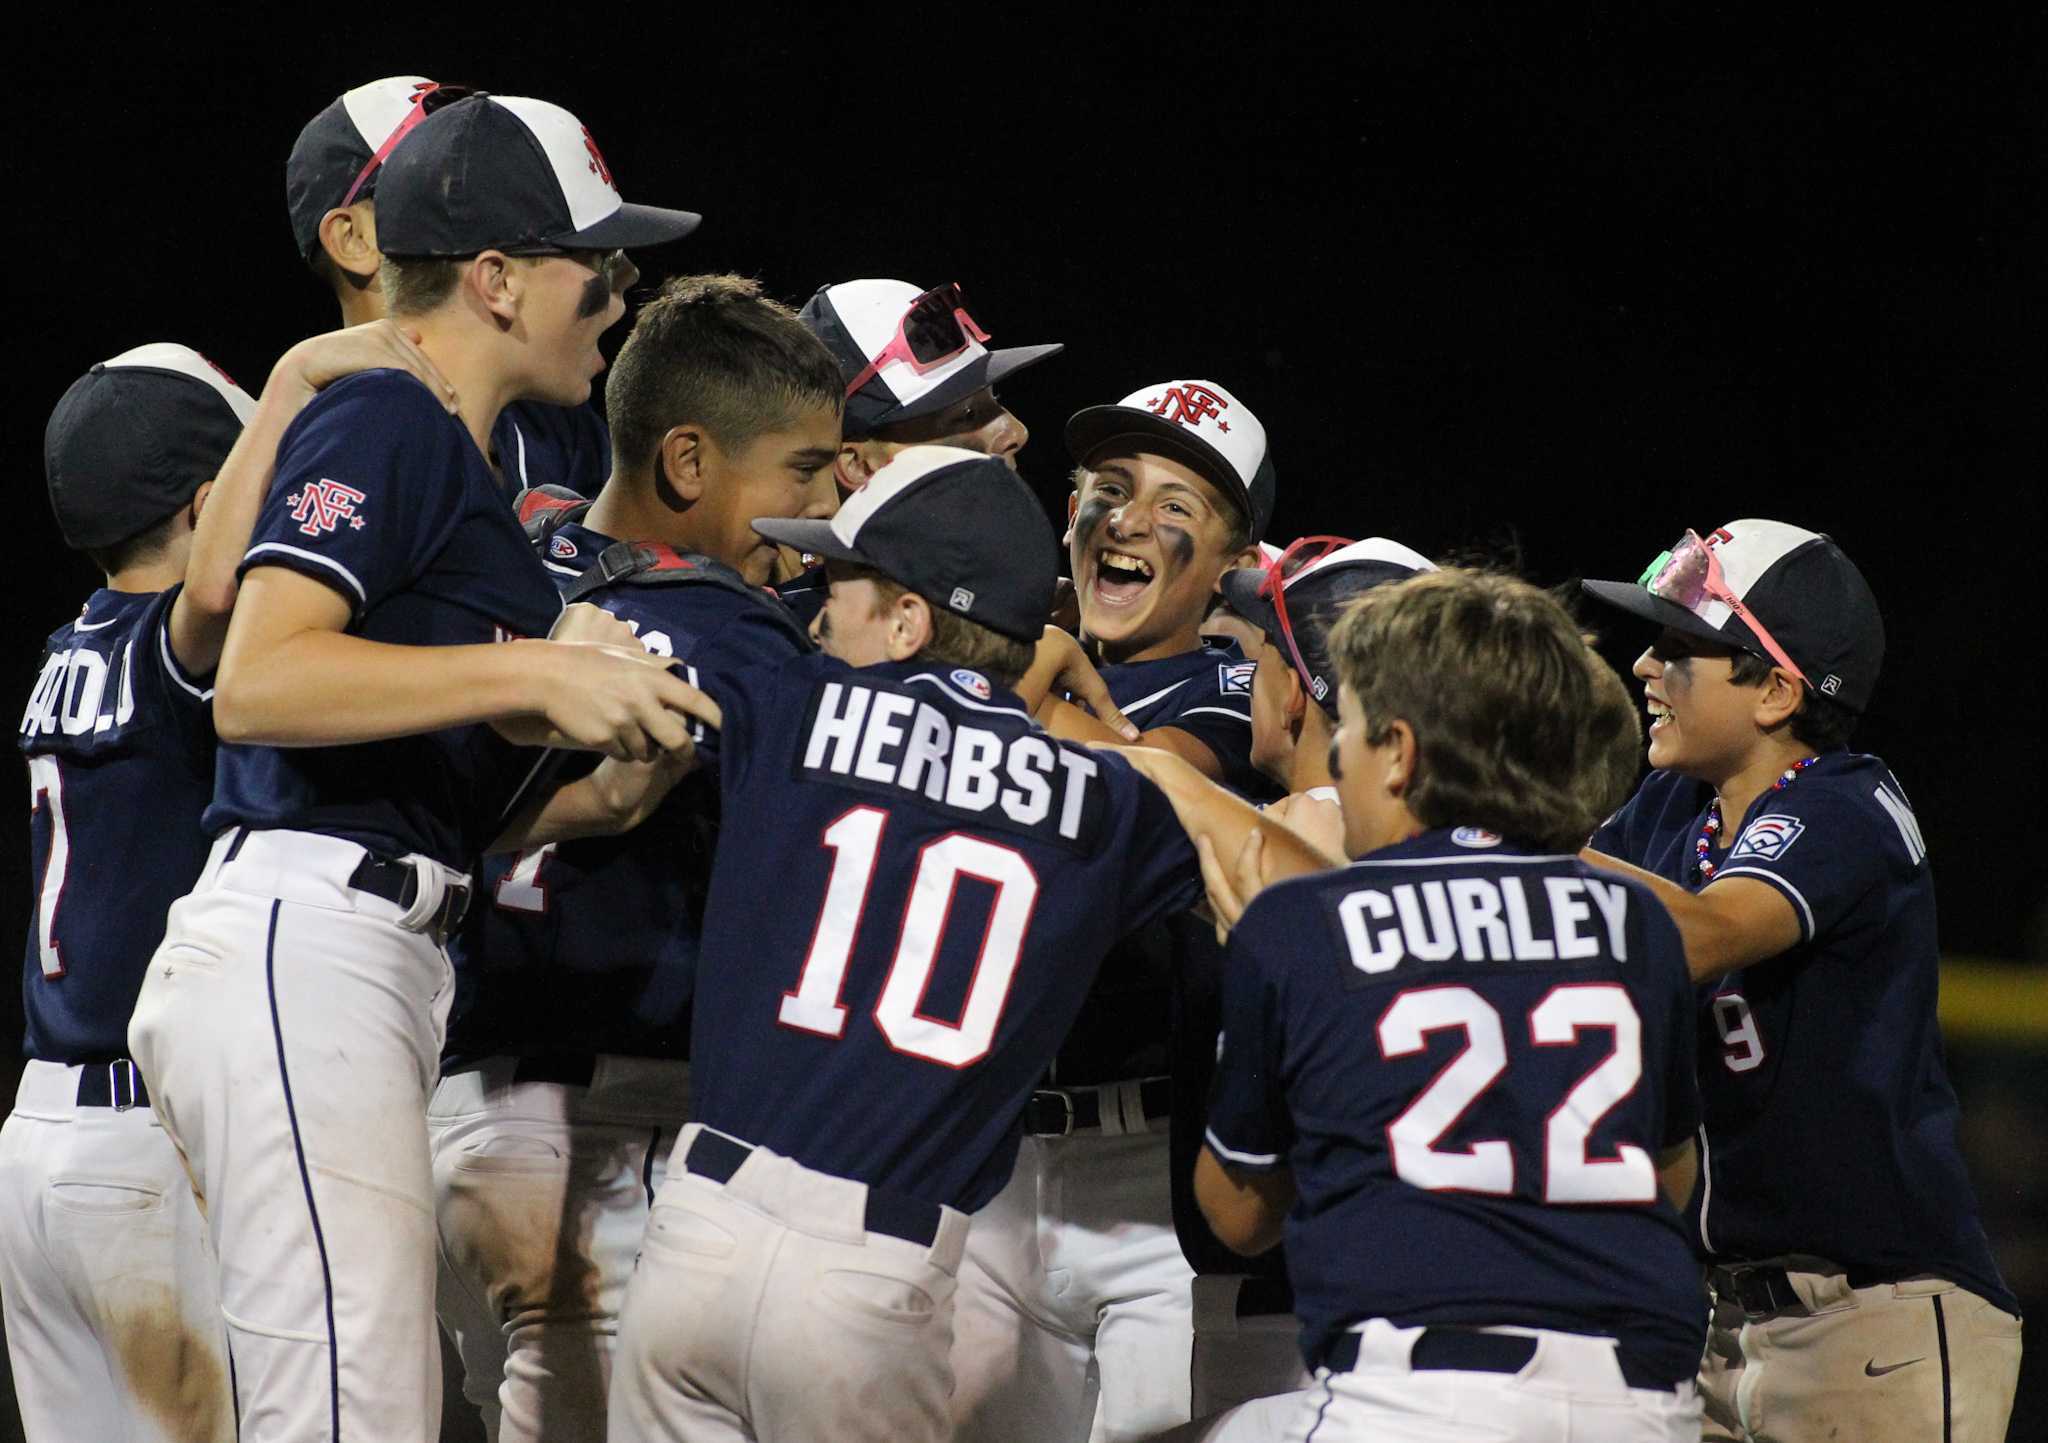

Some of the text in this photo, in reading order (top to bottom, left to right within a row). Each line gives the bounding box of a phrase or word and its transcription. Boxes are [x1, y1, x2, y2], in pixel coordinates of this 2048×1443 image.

[803, 682, 1099, 840] HERBST
[776, 803, 1040, 1071] 10
[1338, 876, 1628, 975] CURLEY
[1376, 982, 1660, 1205] 22
[1711, 991, 1768, 1074] 9
